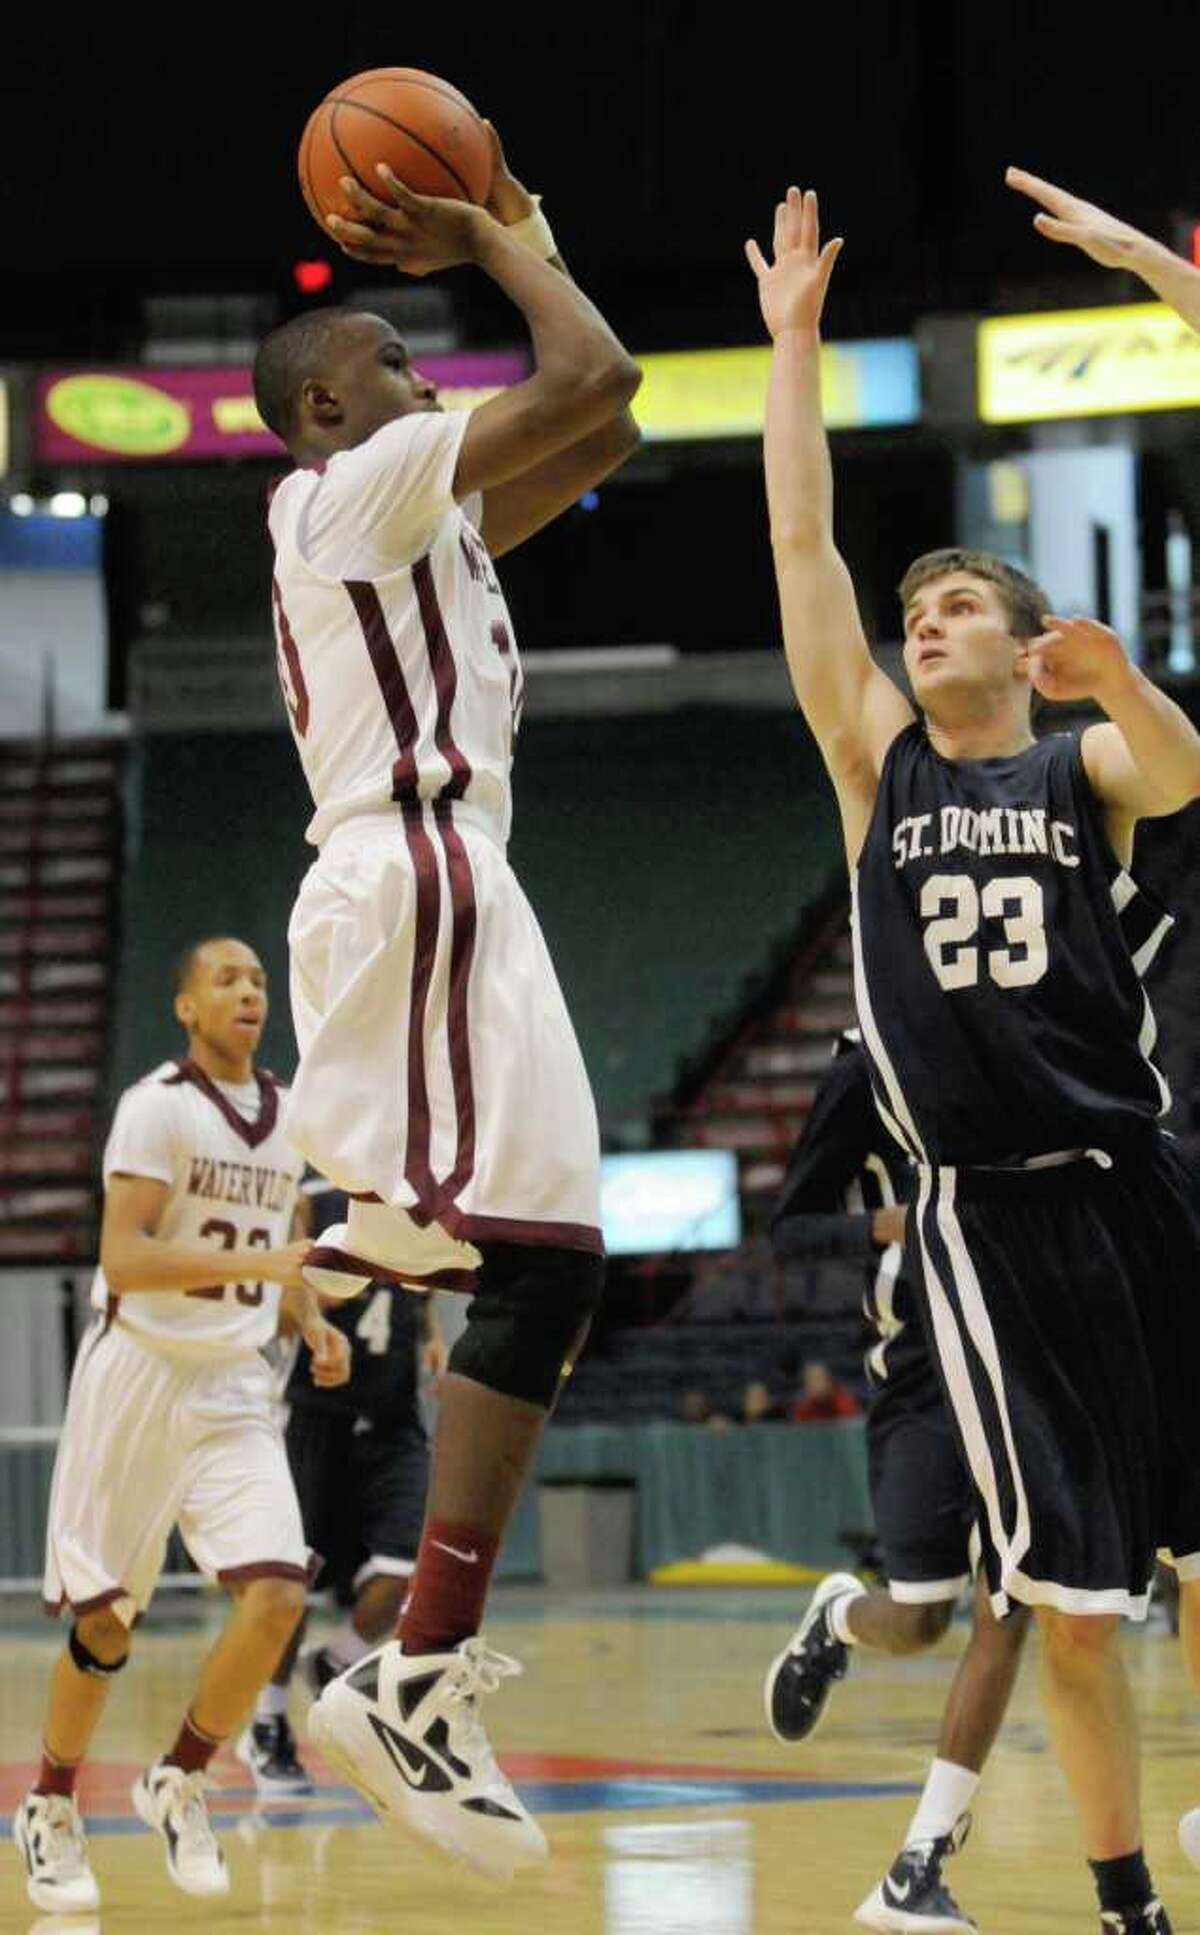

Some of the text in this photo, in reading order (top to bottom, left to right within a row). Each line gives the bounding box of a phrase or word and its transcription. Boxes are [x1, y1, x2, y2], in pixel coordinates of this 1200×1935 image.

[892, 805, 1081, 869] ST. DOMINC
[920, 874, 1048, 991] 23
